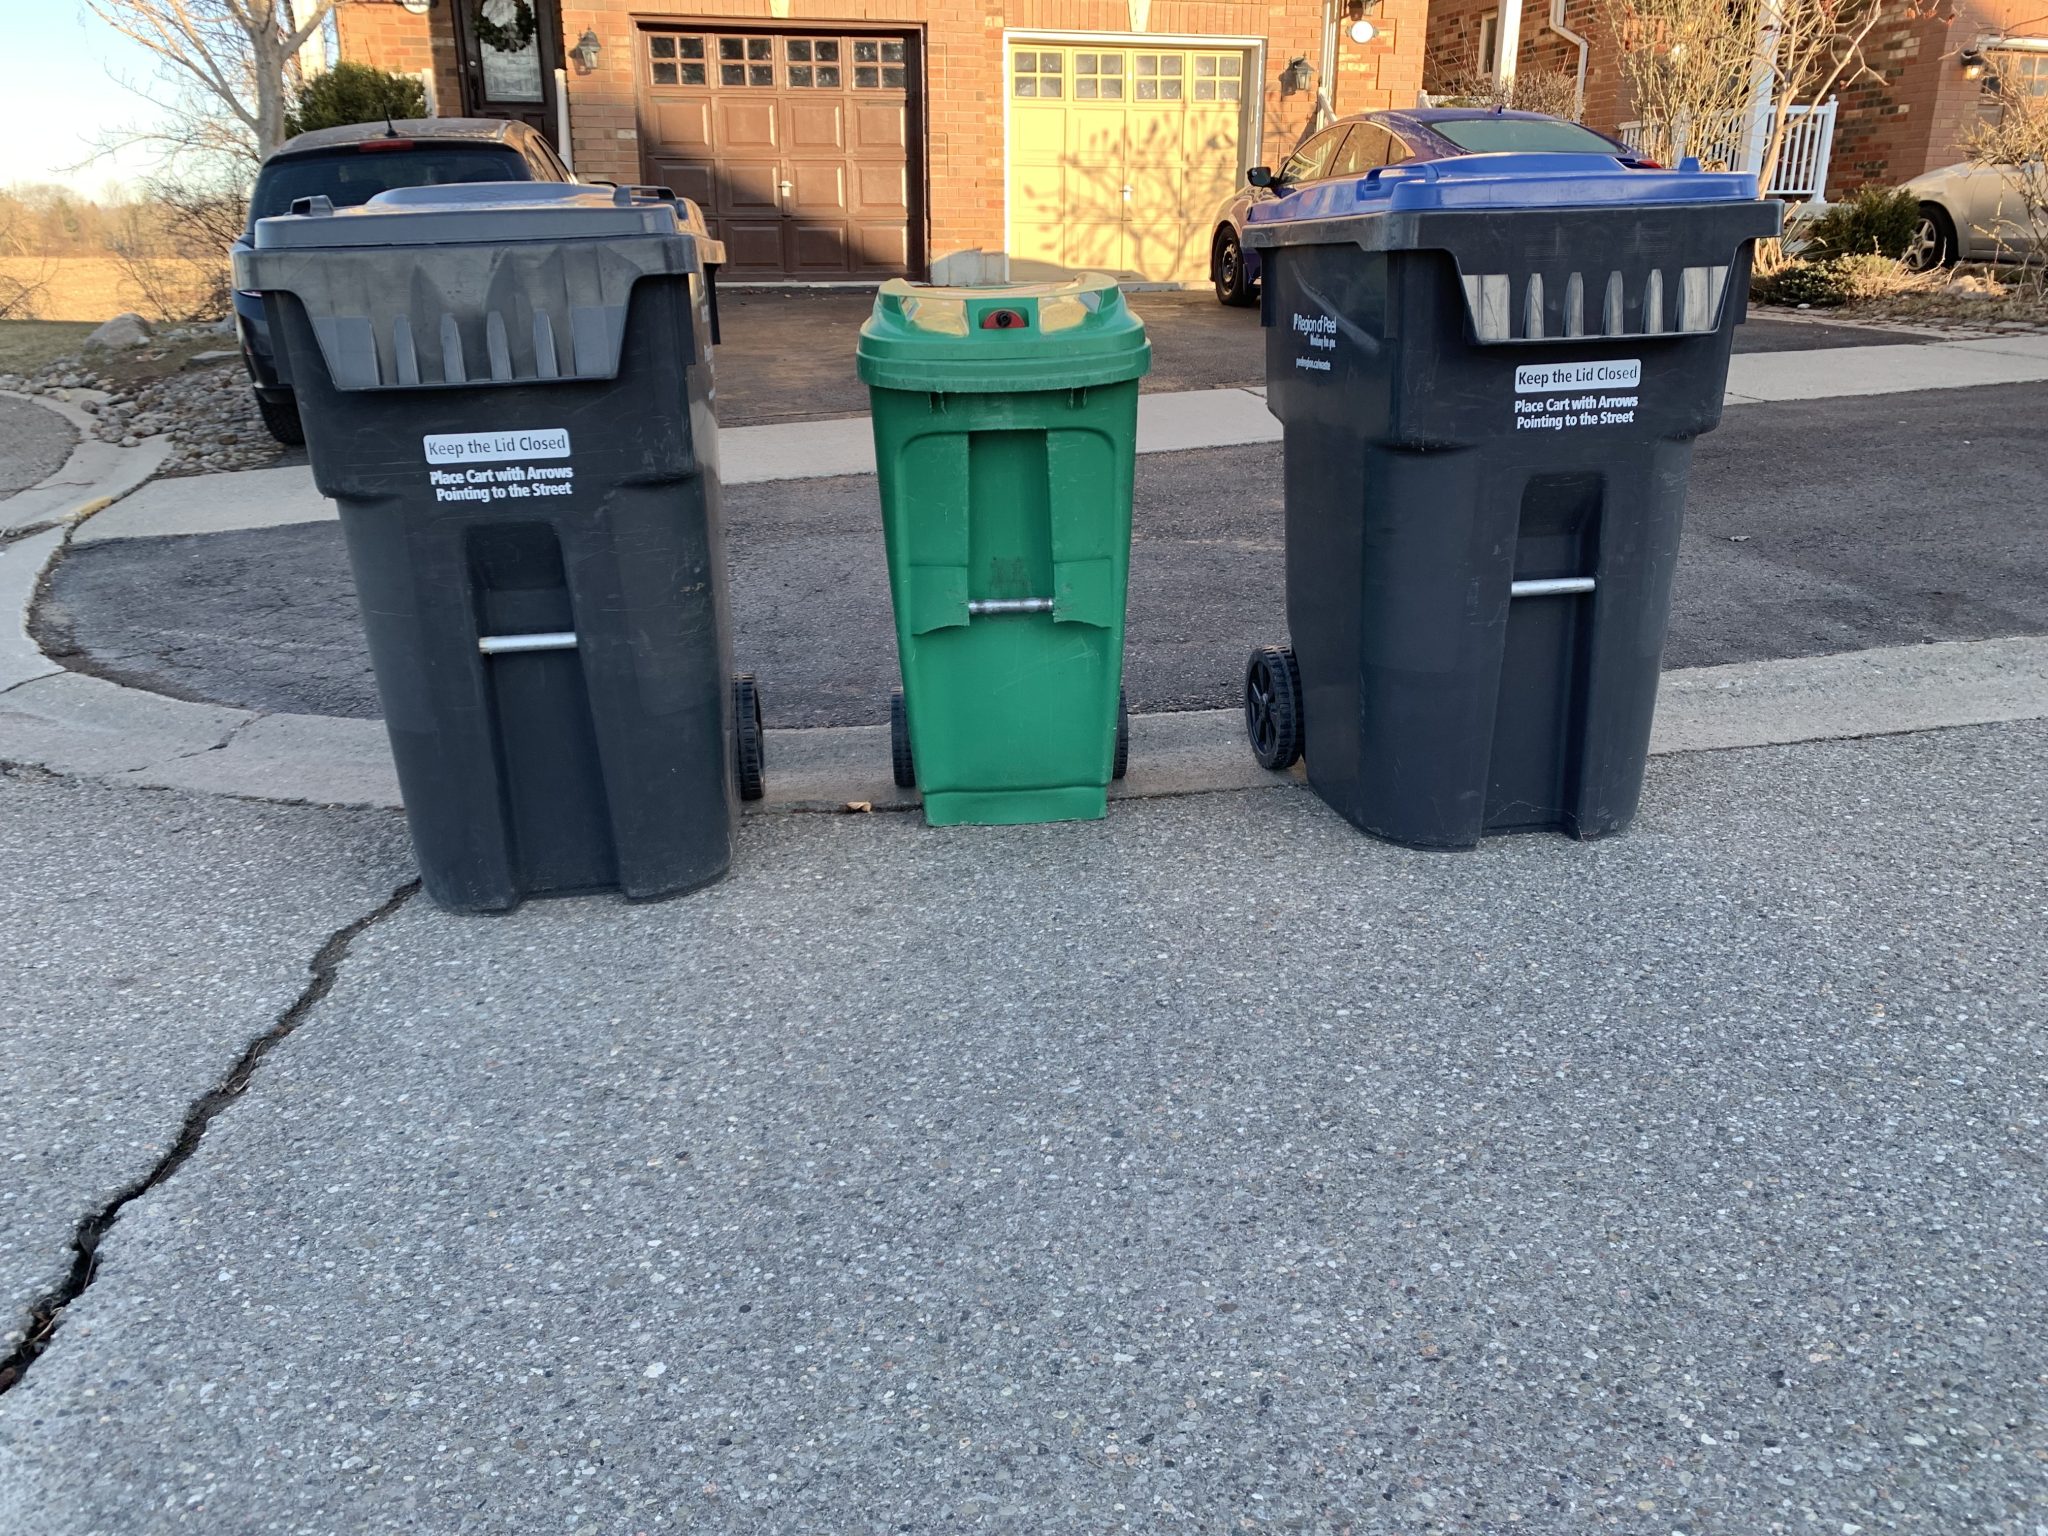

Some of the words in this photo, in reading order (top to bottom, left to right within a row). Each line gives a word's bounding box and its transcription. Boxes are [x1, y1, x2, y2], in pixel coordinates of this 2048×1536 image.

[1298, 314, 1316, 335] Region
[1317, 315, 1324, 332] of
[1324, 316, 1336, 333] Peel
[1518, 371, 1549, 387] Keep
[1552, 369, 1572, 383] the
[1576, 367, 1593, 382] Lid
[1597, 365, 1637, 380] Closed
[1514, 400, 1543, 413] Place
[1546, 398, 1570, 411] Cart
[1571, 396, 1597, 410] with
[1598, 395, 1639, 409] Arrows
[1516, 414, 1563, 431] Pointing
[1565, 413, 1577, 426] to
[1580, 411, 1598, 425] the
[1600, 410, 1635, 424] Street
[428, 441, 464, 458] Keep
[467, 439, 491, 453] the
[494, 437, 515, 452] Lid
[520, 434, 566, 451] Closed
[429, 470, 465, 485] Place
[465, 469, 495, 483] Cart
[494, 466, 526, 482] with
[526, 466, 574, 480] Arrows
[435, 485, 490, 503] Pointing
[491, 485, 506, 499] to
[507, 483, 531, 498] the
[531, 481, 573, 497] Street
